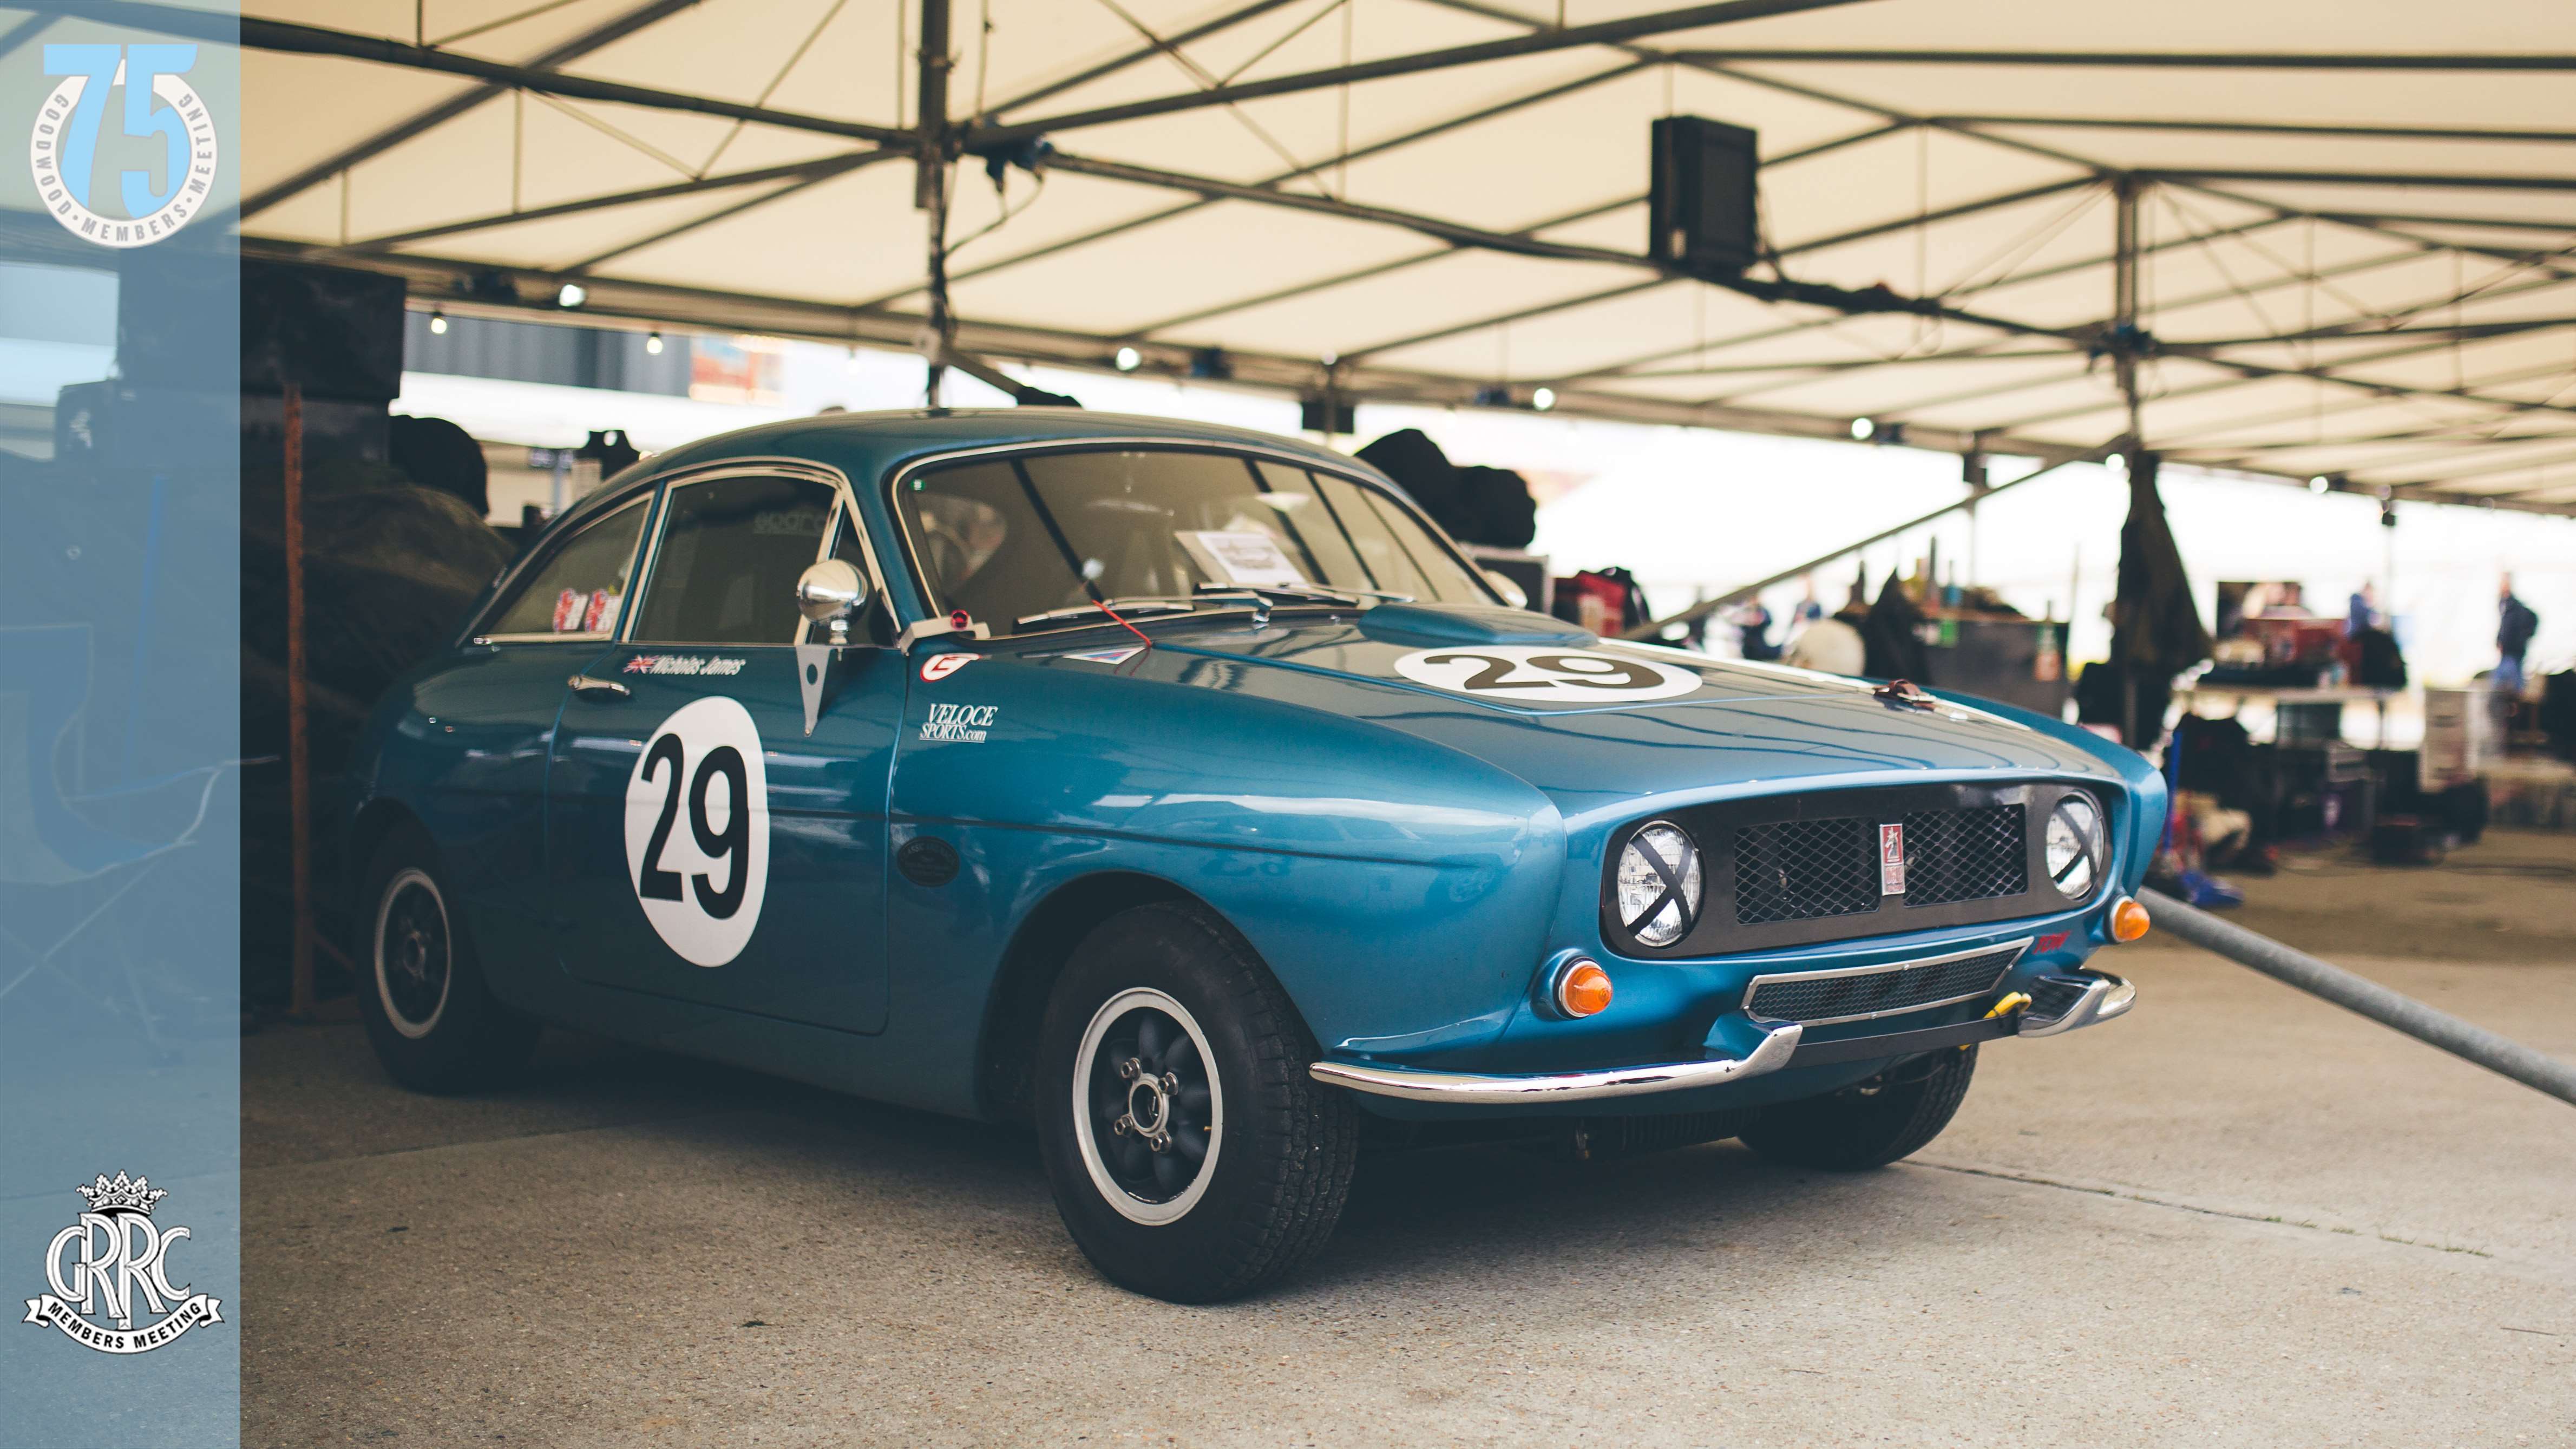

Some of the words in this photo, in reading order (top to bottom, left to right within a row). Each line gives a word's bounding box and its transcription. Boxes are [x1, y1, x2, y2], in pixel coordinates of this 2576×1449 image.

[700, 655, 746, 675] James
[1424, 654, 1665, 690] 29
[928, 703, 998, 726] VELOCE
[920, 722, 987, 742] SPORTS.com
[640, 733, 750, 920] 29
[2033, 930, 2071, 955] TOW
